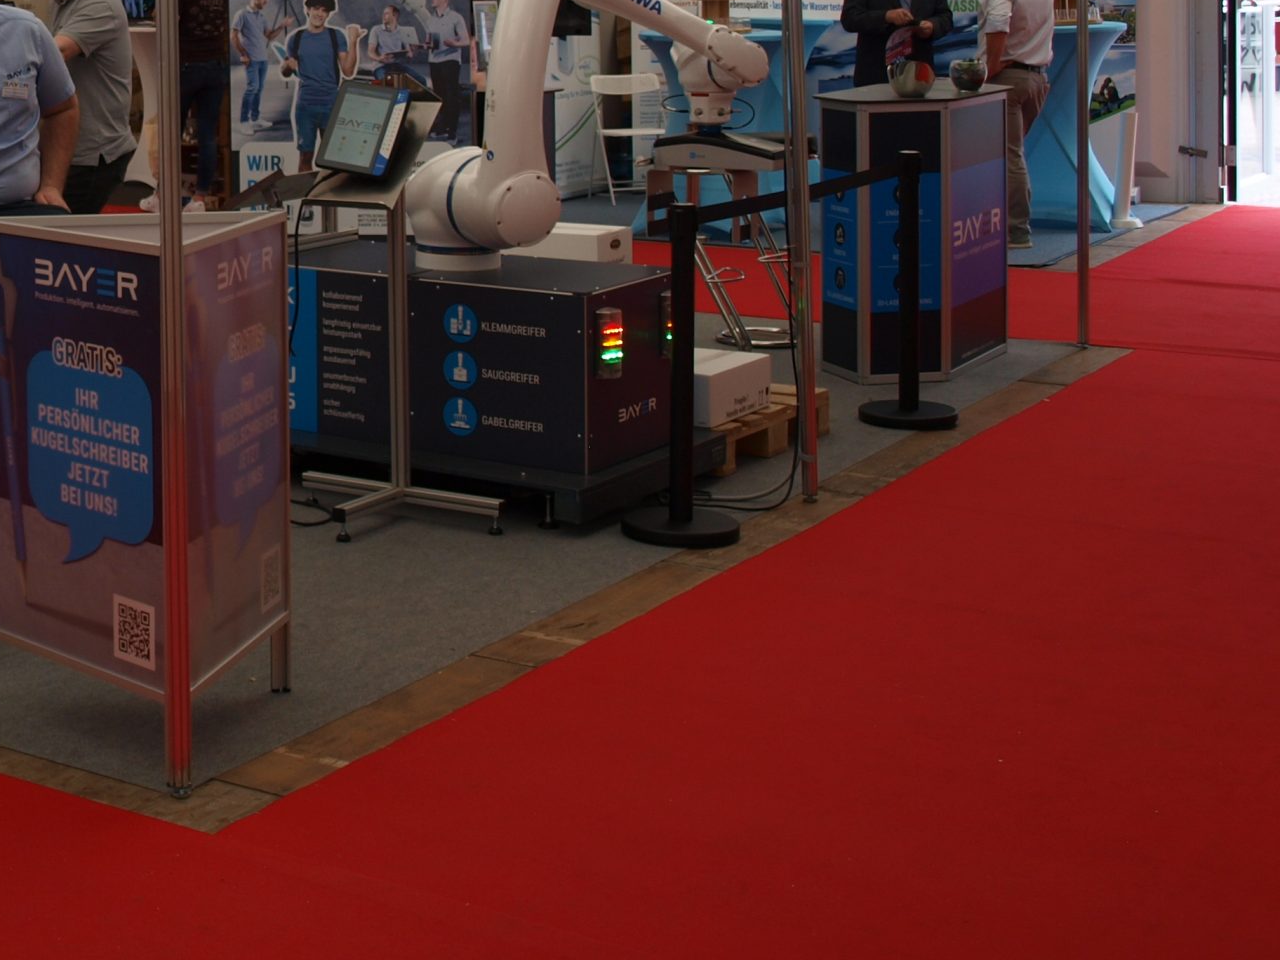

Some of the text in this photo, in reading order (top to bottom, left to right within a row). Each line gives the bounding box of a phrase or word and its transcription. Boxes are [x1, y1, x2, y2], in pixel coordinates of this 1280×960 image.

[730, 0, 768, 10] ebensqualität
[336, 117, 383, 132] BAYER
[247, 155, 282, 171] WIR
[34, 257, 139, 301] BAYER
[481, 320, 546, 338] KLEMMGREIFER
[51, 335, 123, 379] GRATIS:
[481, 368, 540, 386] SAUGGREIFER
[74, 387, 99, 411] IHR
[618, 397, 657, 423] BAYER
[37, 403, 140, 446] PERSÖNLICHER
[481, 415, 544, 433] GABELGREIFER
[31, 426, 149, 474] KUGELSCHREIBER
[67, 461, 109, 488] JETZT
[60, 483, 118, 517] BEI UNS!
